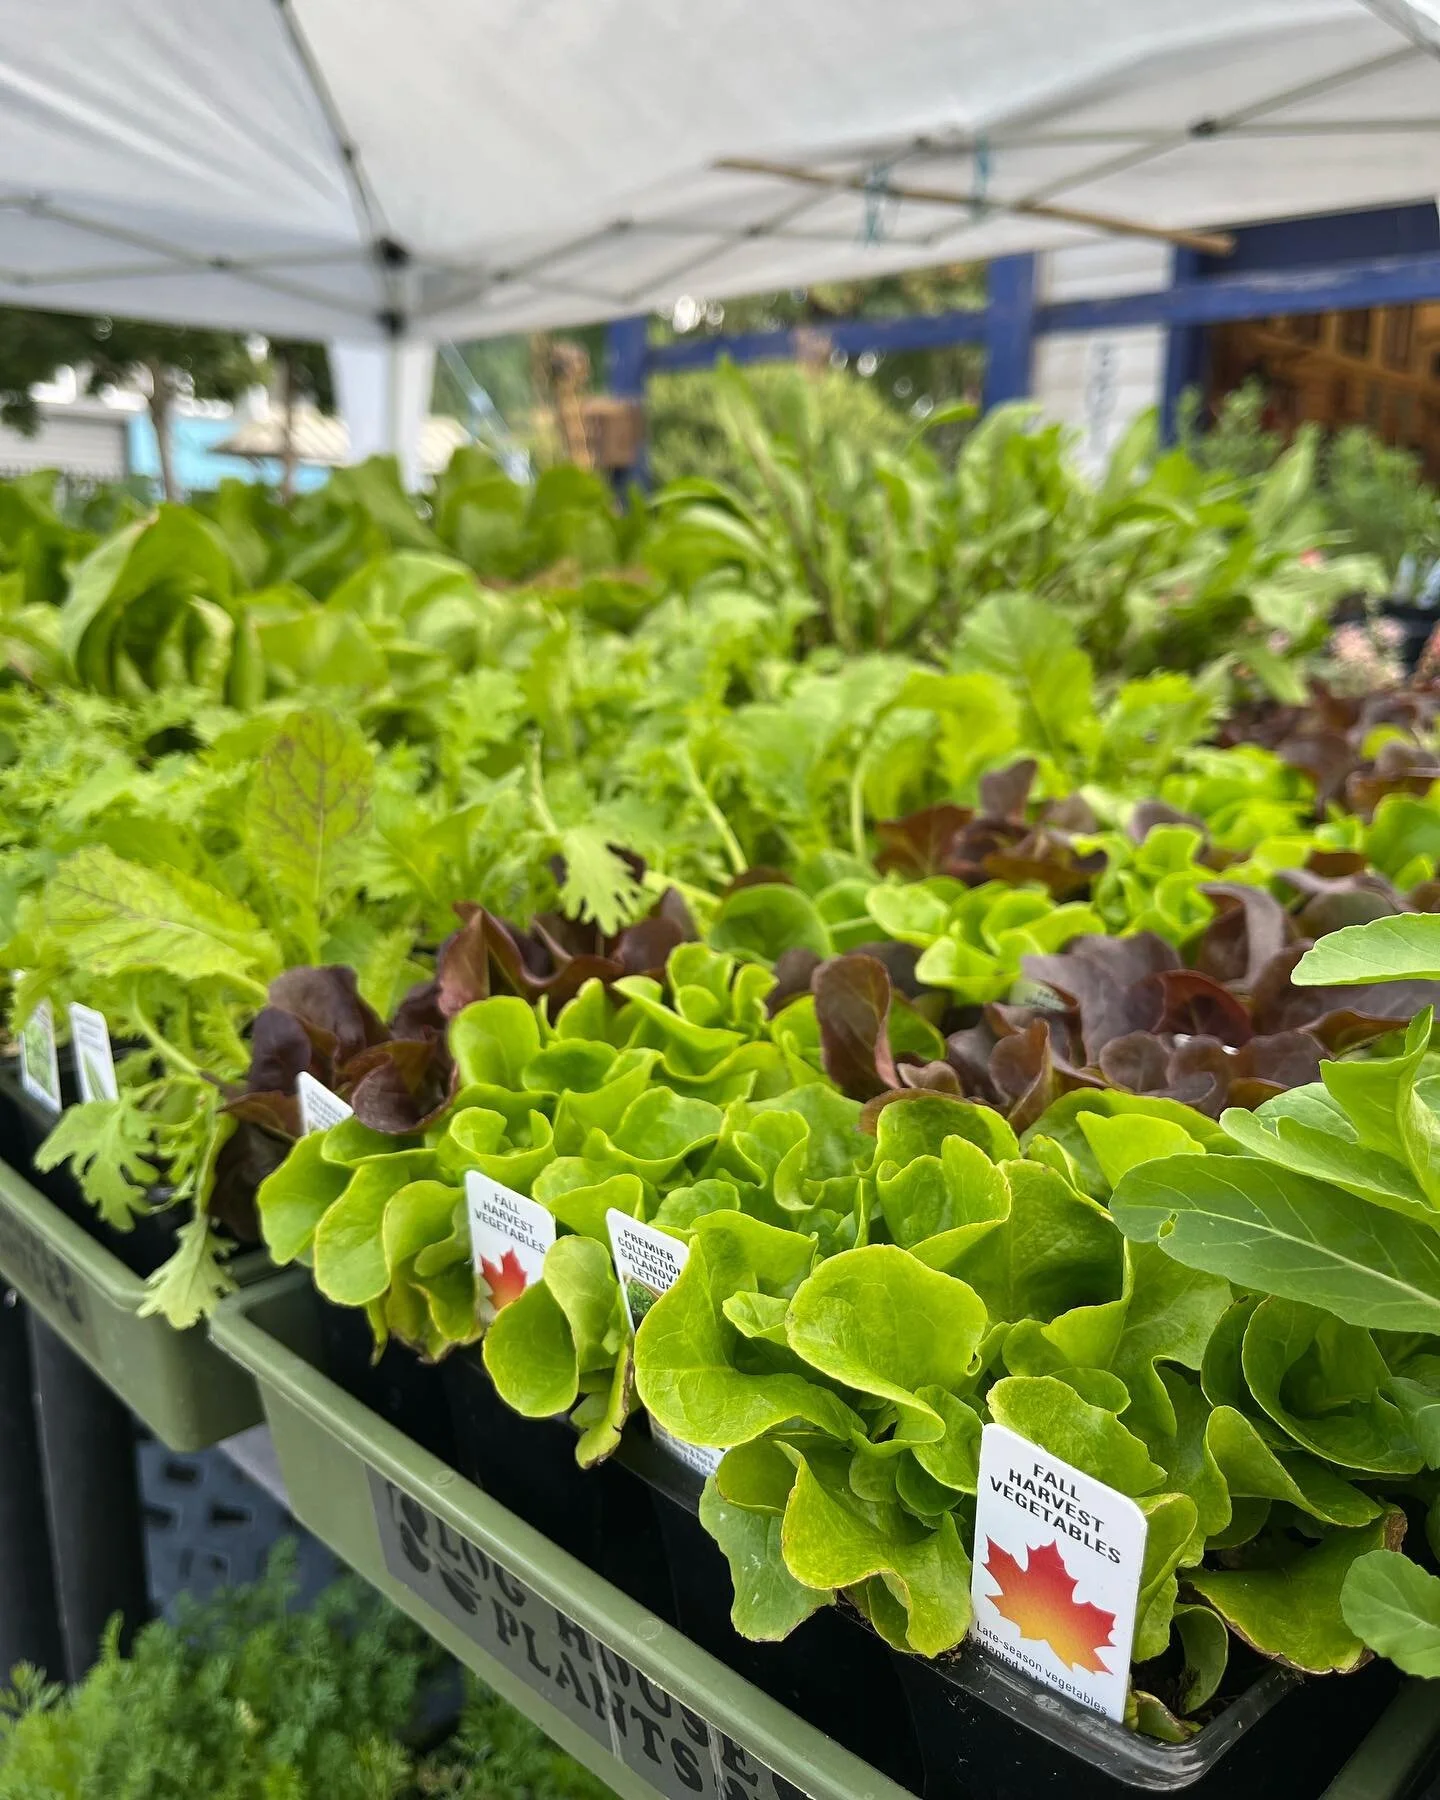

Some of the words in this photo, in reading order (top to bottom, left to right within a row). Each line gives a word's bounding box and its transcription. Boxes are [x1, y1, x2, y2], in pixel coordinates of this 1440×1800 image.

[483, 1201, 535, 1235] HARVEST
[494, 1193, 521, 1215] FALL
[475, 1208, 546, 1254] VEGETABLES
[623, 1229, 675, 1263] PREMIER
[620, 1248, 678, 1284] SALANOV
[1009, 1468, 1105, 1533] HARVEST
[1033, 1463, 1081, 1502] FALL
[990, 1475, 1121, 1564] VEGETABLES
[436, 1516, 526, 1607] LOG
[555, 1608, 759, 1787] HOUSE
[976, 1620, 1042, 1673] Late-season
[1045, 1667, 1108, 1716] vegetables
[490, 1595, 704, 1793] PLANTS
